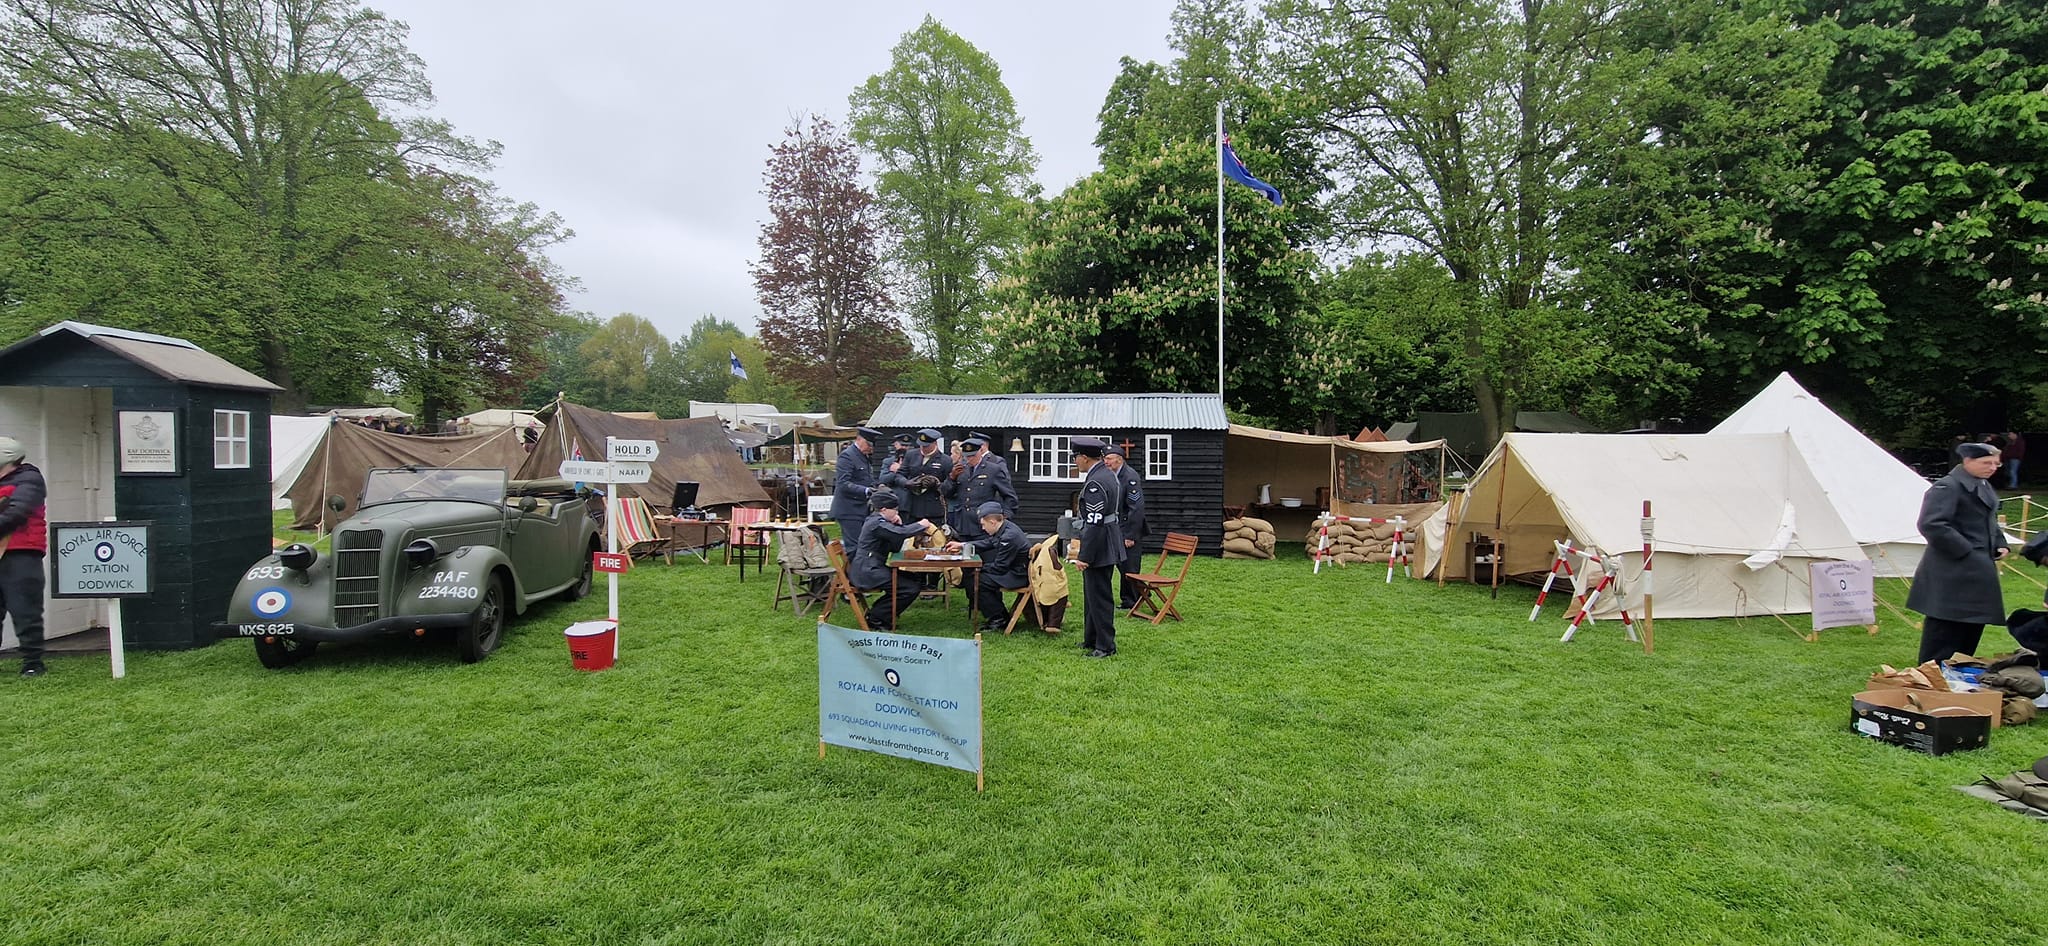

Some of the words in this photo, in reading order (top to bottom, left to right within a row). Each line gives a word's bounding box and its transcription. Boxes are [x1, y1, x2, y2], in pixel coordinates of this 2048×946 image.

[614, 445, 640, 455] HOLD
[645, 445, 652, 455] B
[1086, 511, 1103, 524] SP
[60, 531, 94, 558] ROYAL
[95, 529, 113, 541] AIR
[114, 530, 148, 558] FORCE
[82, 564, 130, 575] STATION
[599, 557, 621, 569] FIRE
[246, 566, 287, 581] 693
[433, 570, 470, 584] RAF
[78, 579, 134, 590] DODWICK
[417, 585, 479, 599] 2234480
[875, 636, 899, 648] from
[901, 639, 918, 651] the
[920, 643, 943, 660] Past
[838, 681, 868, 693] ROYAL
[870, 686, 885, 696] AIR
[887, 688, 914, 703] FORCE
[913, 696, 959, 711] STATION
[875, 702, 922, 719] DODWICK
[828, 712, 840, 721] 693
[840, 714, 881, 729] SQUADRON
[882, 722, 908, 733] LIVING
[908, 727, 942, 739] HISTORY
[848, 732, 950, 760] www.blastsfromthepast.org
